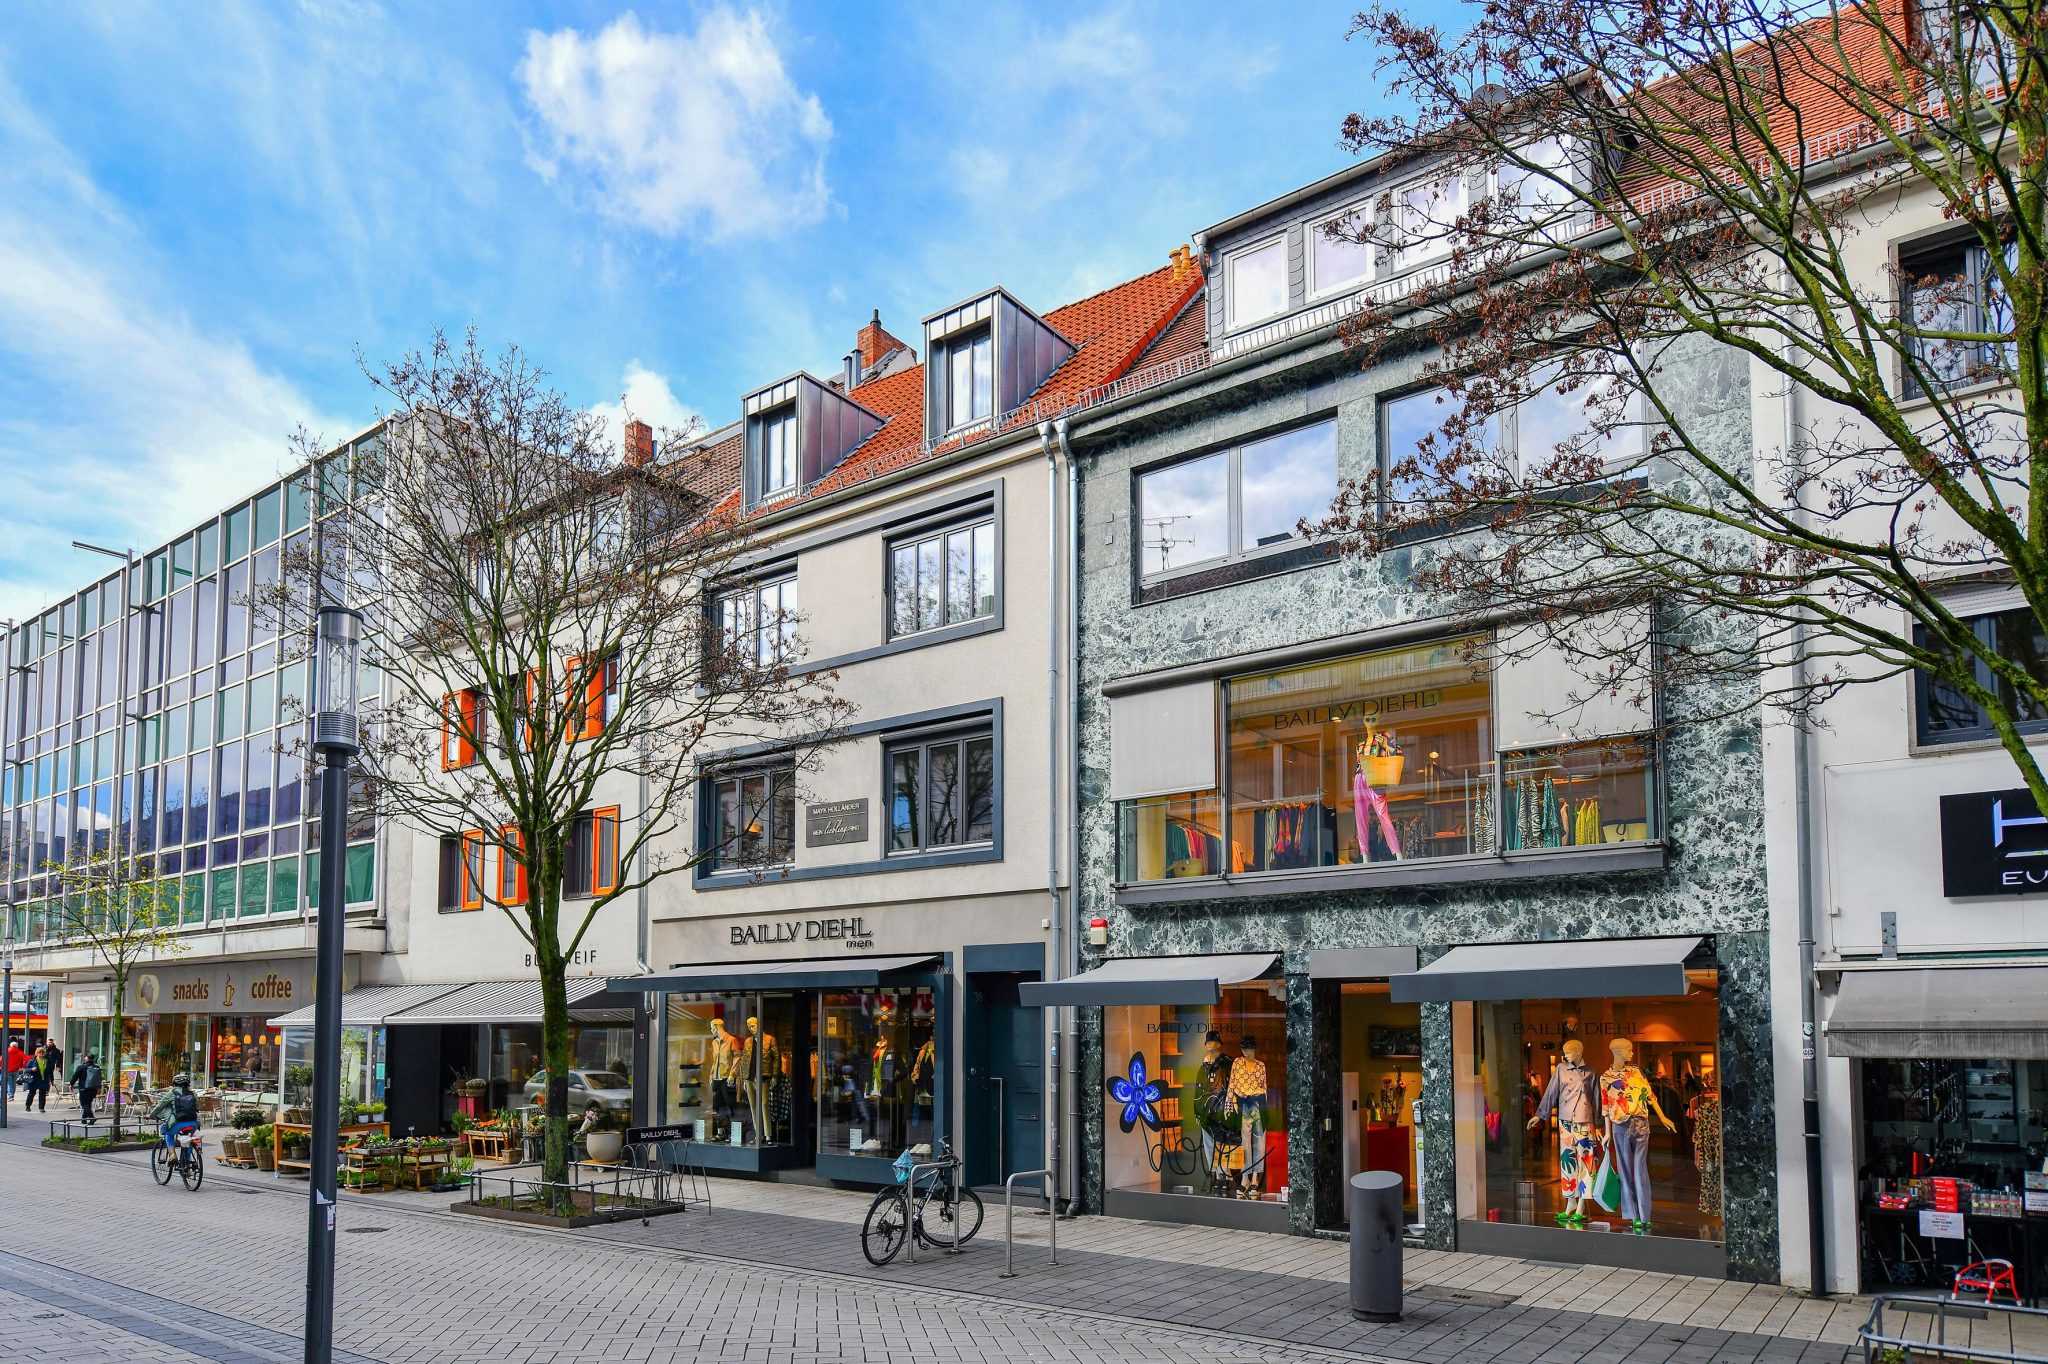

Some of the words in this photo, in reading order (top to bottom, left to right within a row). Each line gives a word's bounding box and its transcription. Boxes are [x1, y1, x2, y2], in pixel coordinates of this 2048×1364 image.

[1274, 702, 1352, 730] BAILLY
[1362, 691, 1438, 716] DIEHL
[729, 921, 801, 945] BAILLY
[804, 917, 873, 940] DIEHL
[846, 939, 873, 949] men
[173, 977, 209, 1000] snacks
[251, 974, 292, 999] coffee
[1146, 1023, 1193, 1034] BAILLY
[1513, 1022, 1578, 1035] BAILLY
[1584, 1022, 1645, 1035] DIEHL
[640, 1130, 663, 1139] BAILLY
